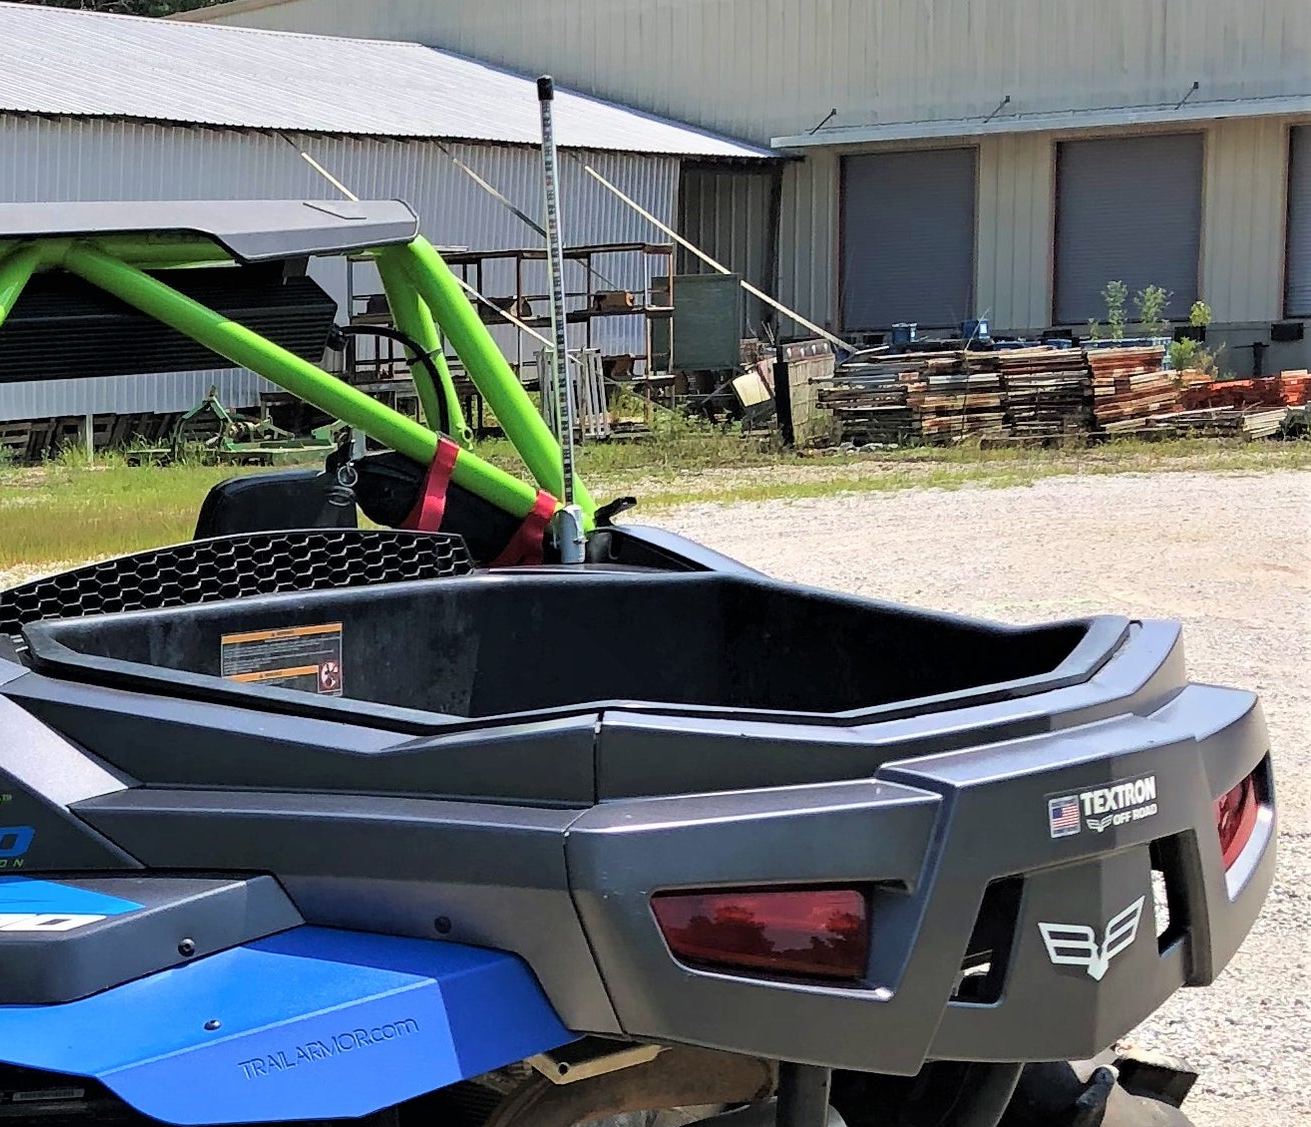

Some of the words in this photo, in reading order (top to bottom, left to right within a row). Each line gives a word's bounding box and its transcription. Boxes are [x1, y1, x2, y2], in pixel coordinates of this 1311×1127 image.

[1079, 775, 1157, 816] TEXTRON
[1112, 811, 1132, 827] OFF
[1132, 803, 1159, 821] ROAD
